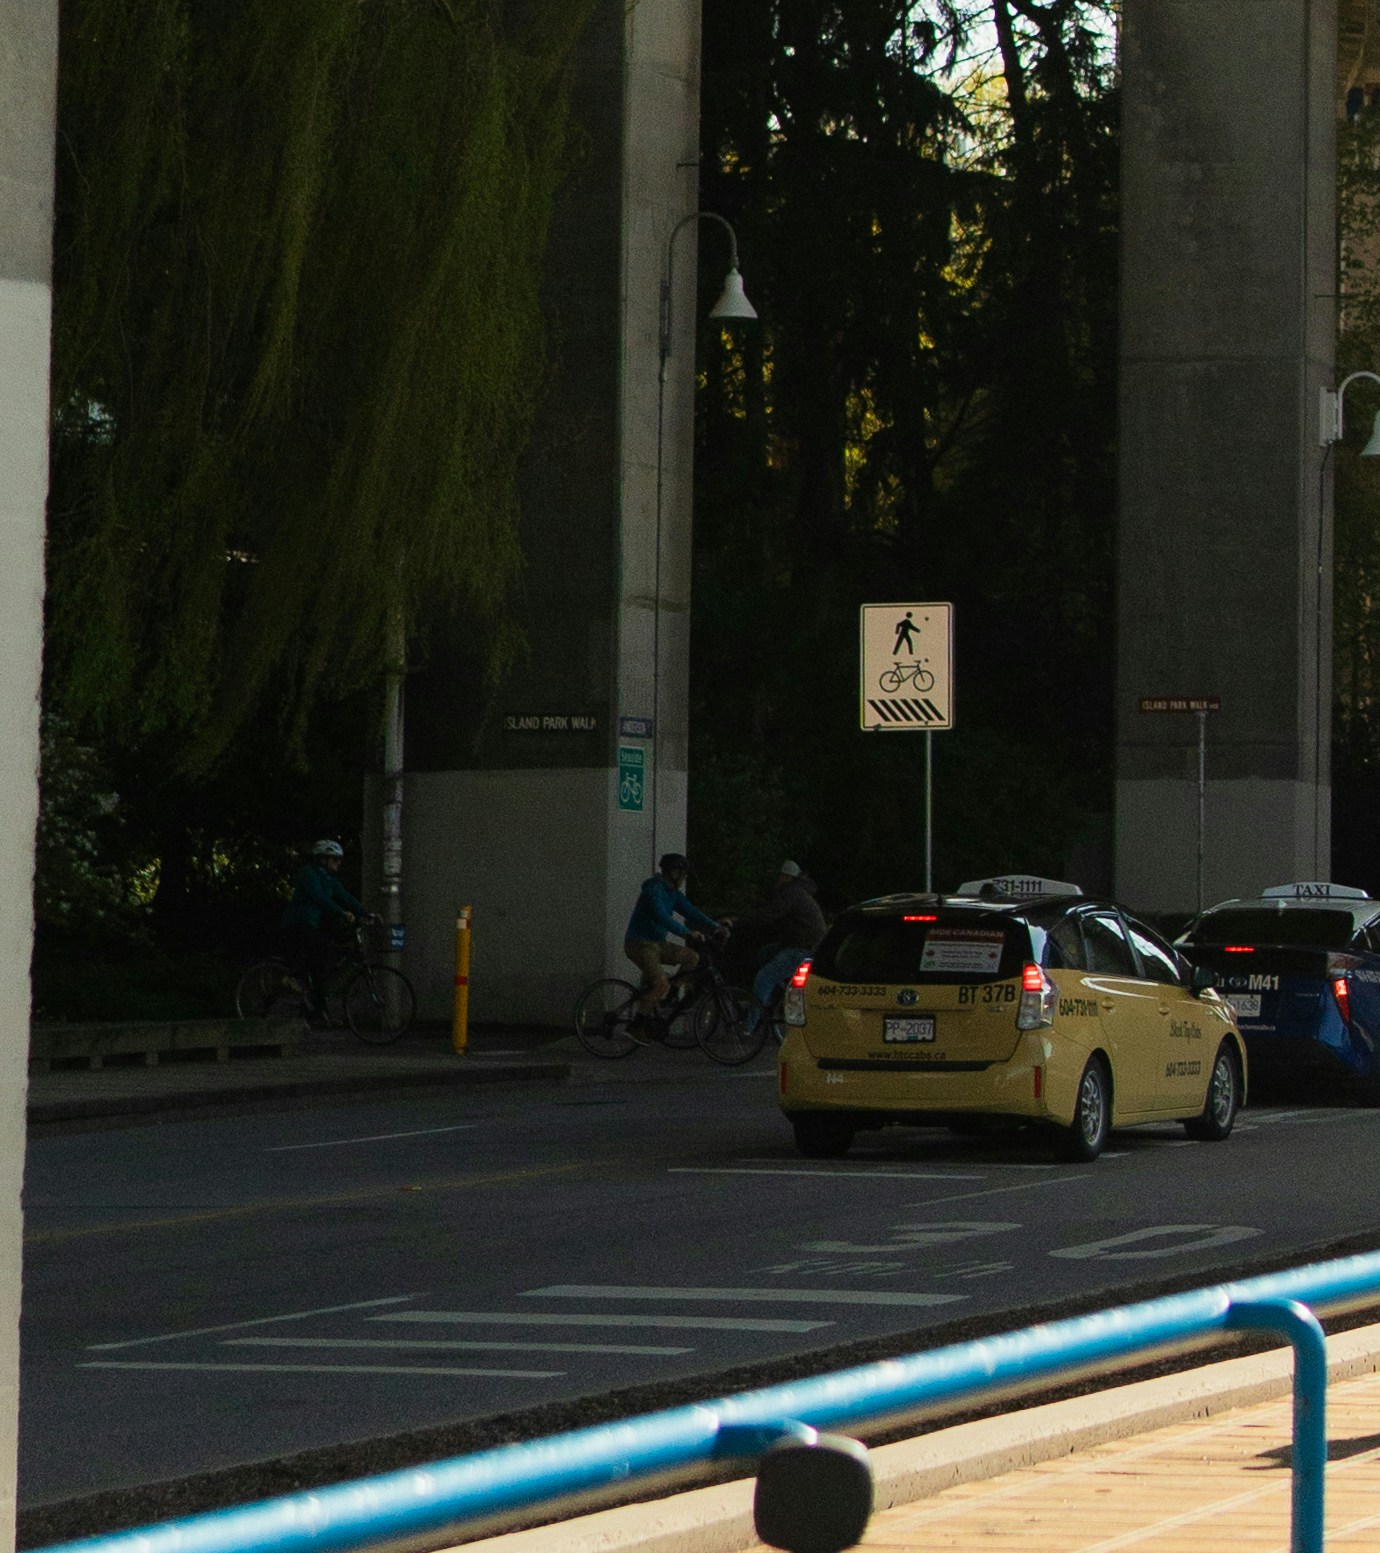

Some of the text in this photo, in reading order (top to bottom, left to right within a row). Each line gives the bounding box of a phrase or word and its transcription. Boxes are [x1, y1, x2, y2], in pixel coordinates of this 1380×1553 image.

[504, 716, 540, 730] ISLAND
[542, 715, 569, 730] PARK
[1293, 884, 1331, 896] TAXI
[1248, 974, 1280, 991] M41
[958, 983, 1016, 1004] BT 37B
